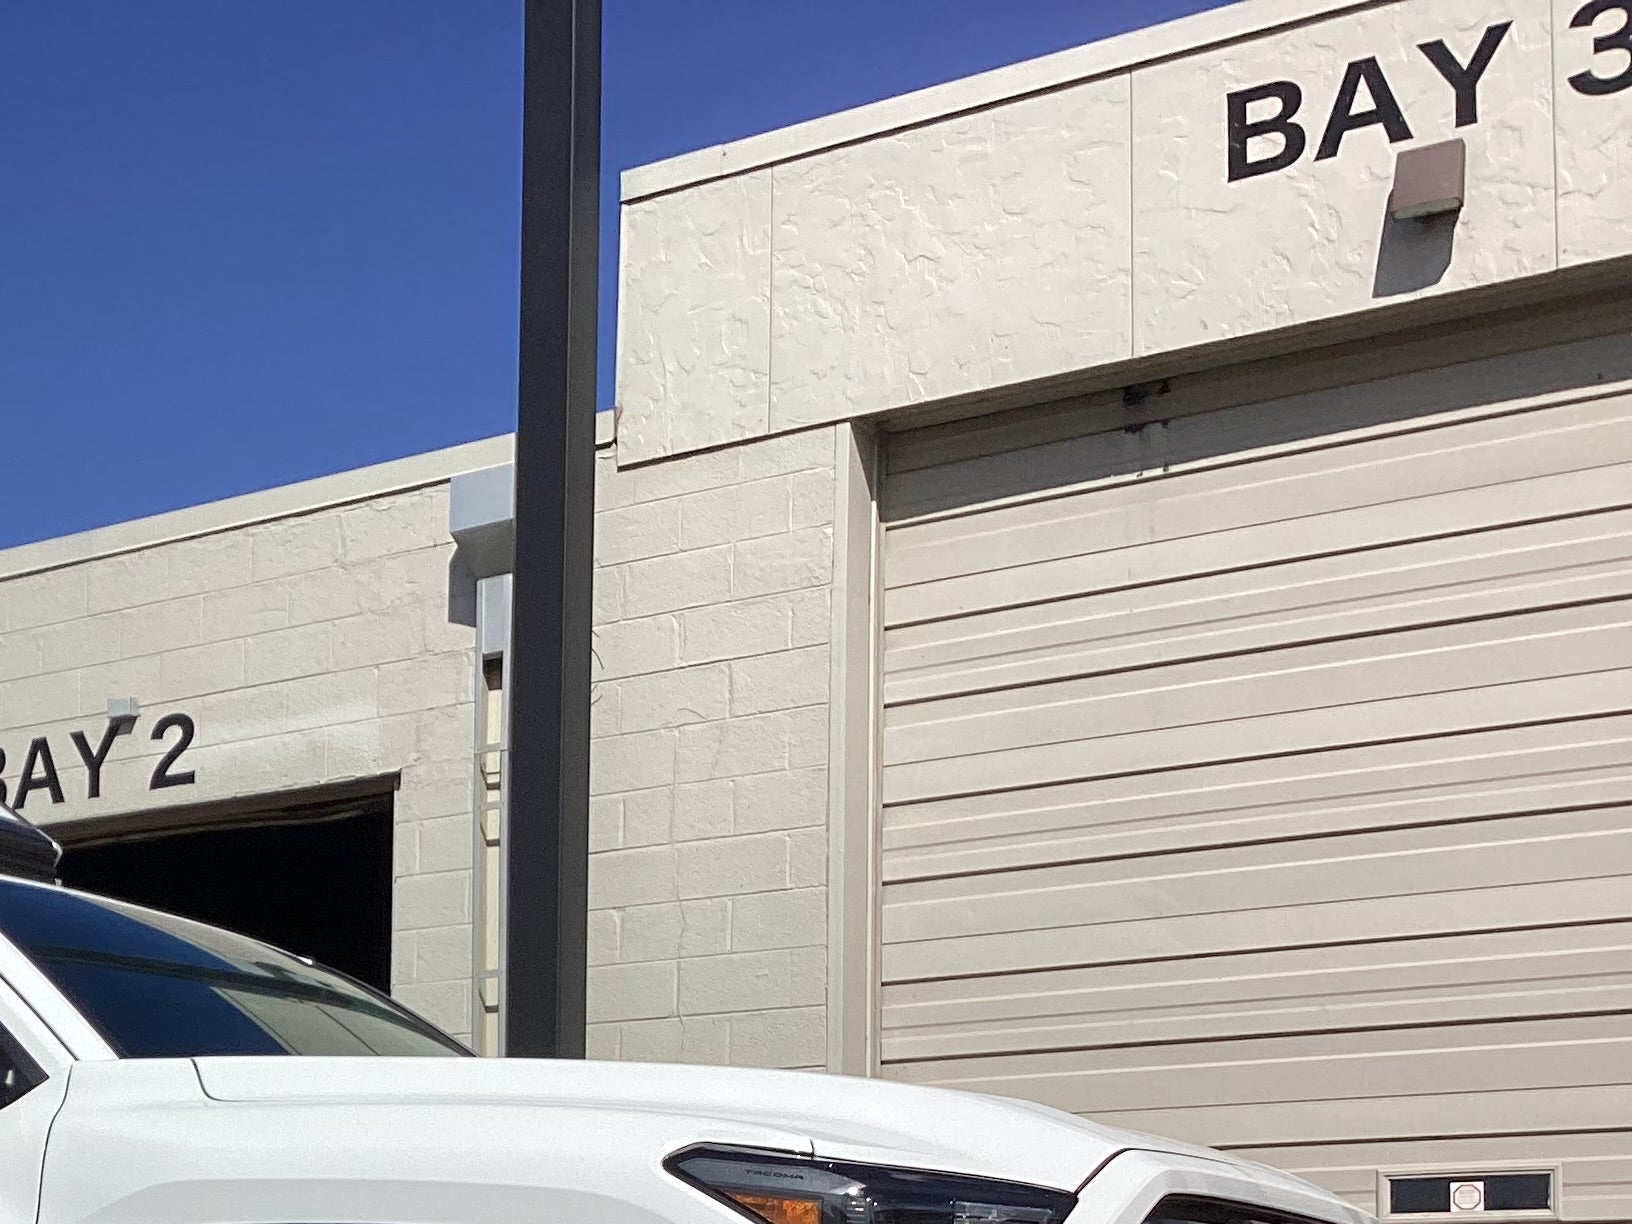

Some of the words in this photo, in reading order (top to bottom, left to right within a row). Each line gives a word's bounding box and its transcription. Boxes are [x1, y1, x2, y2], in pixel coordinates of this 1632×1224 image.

[1226, 19, 1514, 184] BAY
[1567, 0, 1632, 96] 3
[149, 712, 196, 791] 2
[744, 1169, 804, 1180] TACOMA
